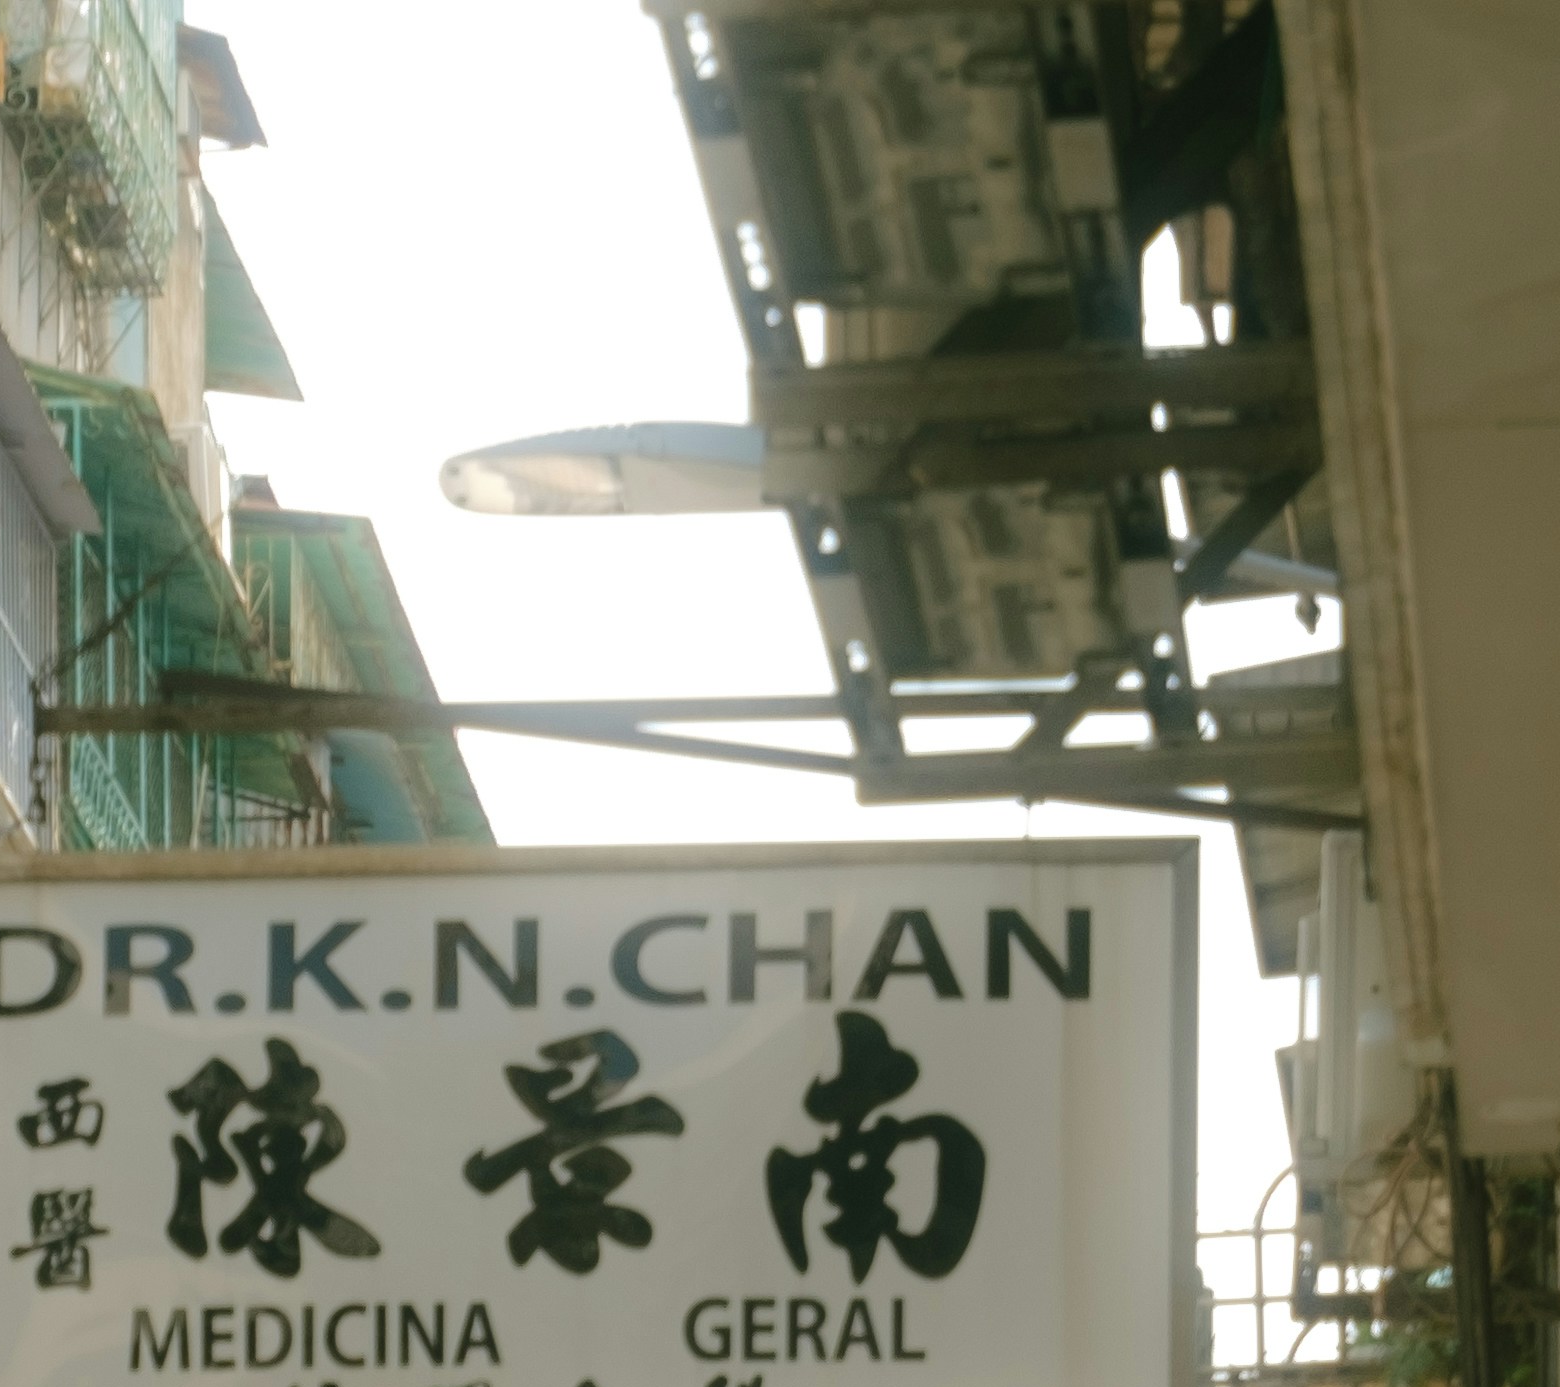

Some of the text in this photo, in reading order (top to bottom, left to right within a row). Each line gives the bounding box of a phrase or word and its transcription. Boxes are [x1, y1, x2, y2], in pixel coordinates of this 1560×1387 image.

[11, 1077, 110, 1293] 西醫
[164, 1012, 986, 1286] 陳景南
[128, 1296, 926, 1376] MEDICINA GERAL
